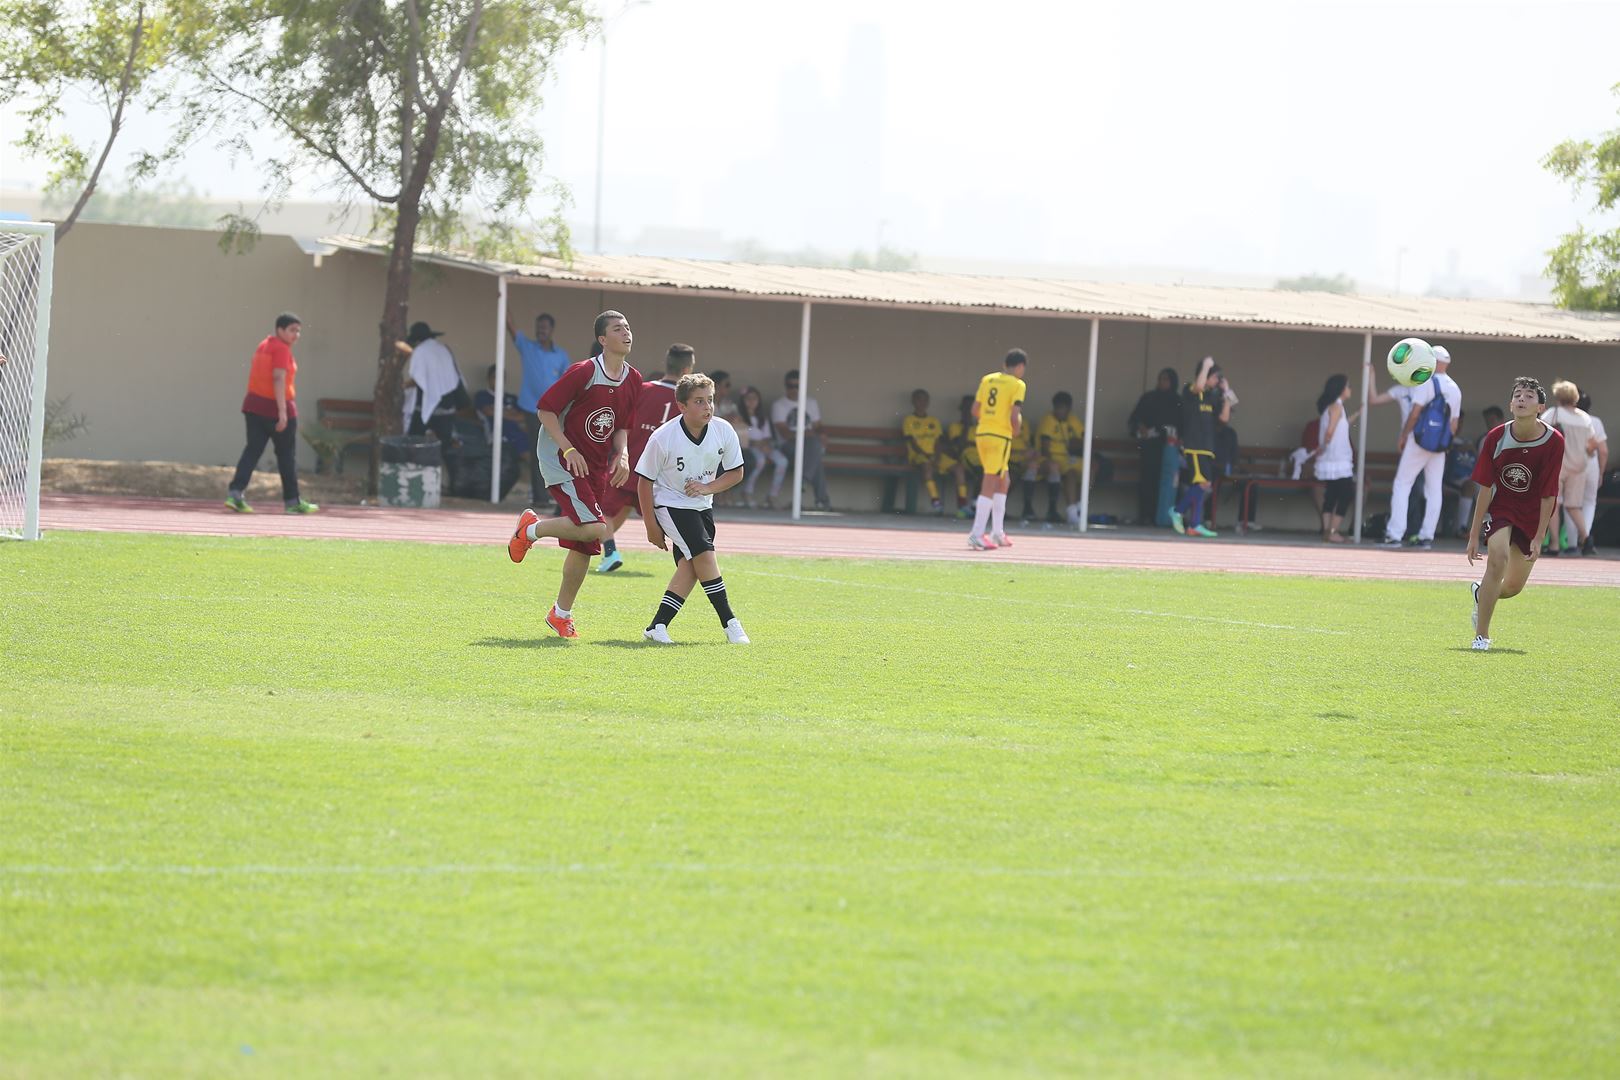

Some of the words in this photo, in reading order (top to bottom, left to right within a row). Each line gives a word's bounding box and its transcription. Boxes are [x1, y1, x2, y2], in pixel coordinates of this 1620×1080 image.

[988, 387, 998, 407] 8
[660, 402, 671, 424] 1
[676, 457, 685, 472] 5
